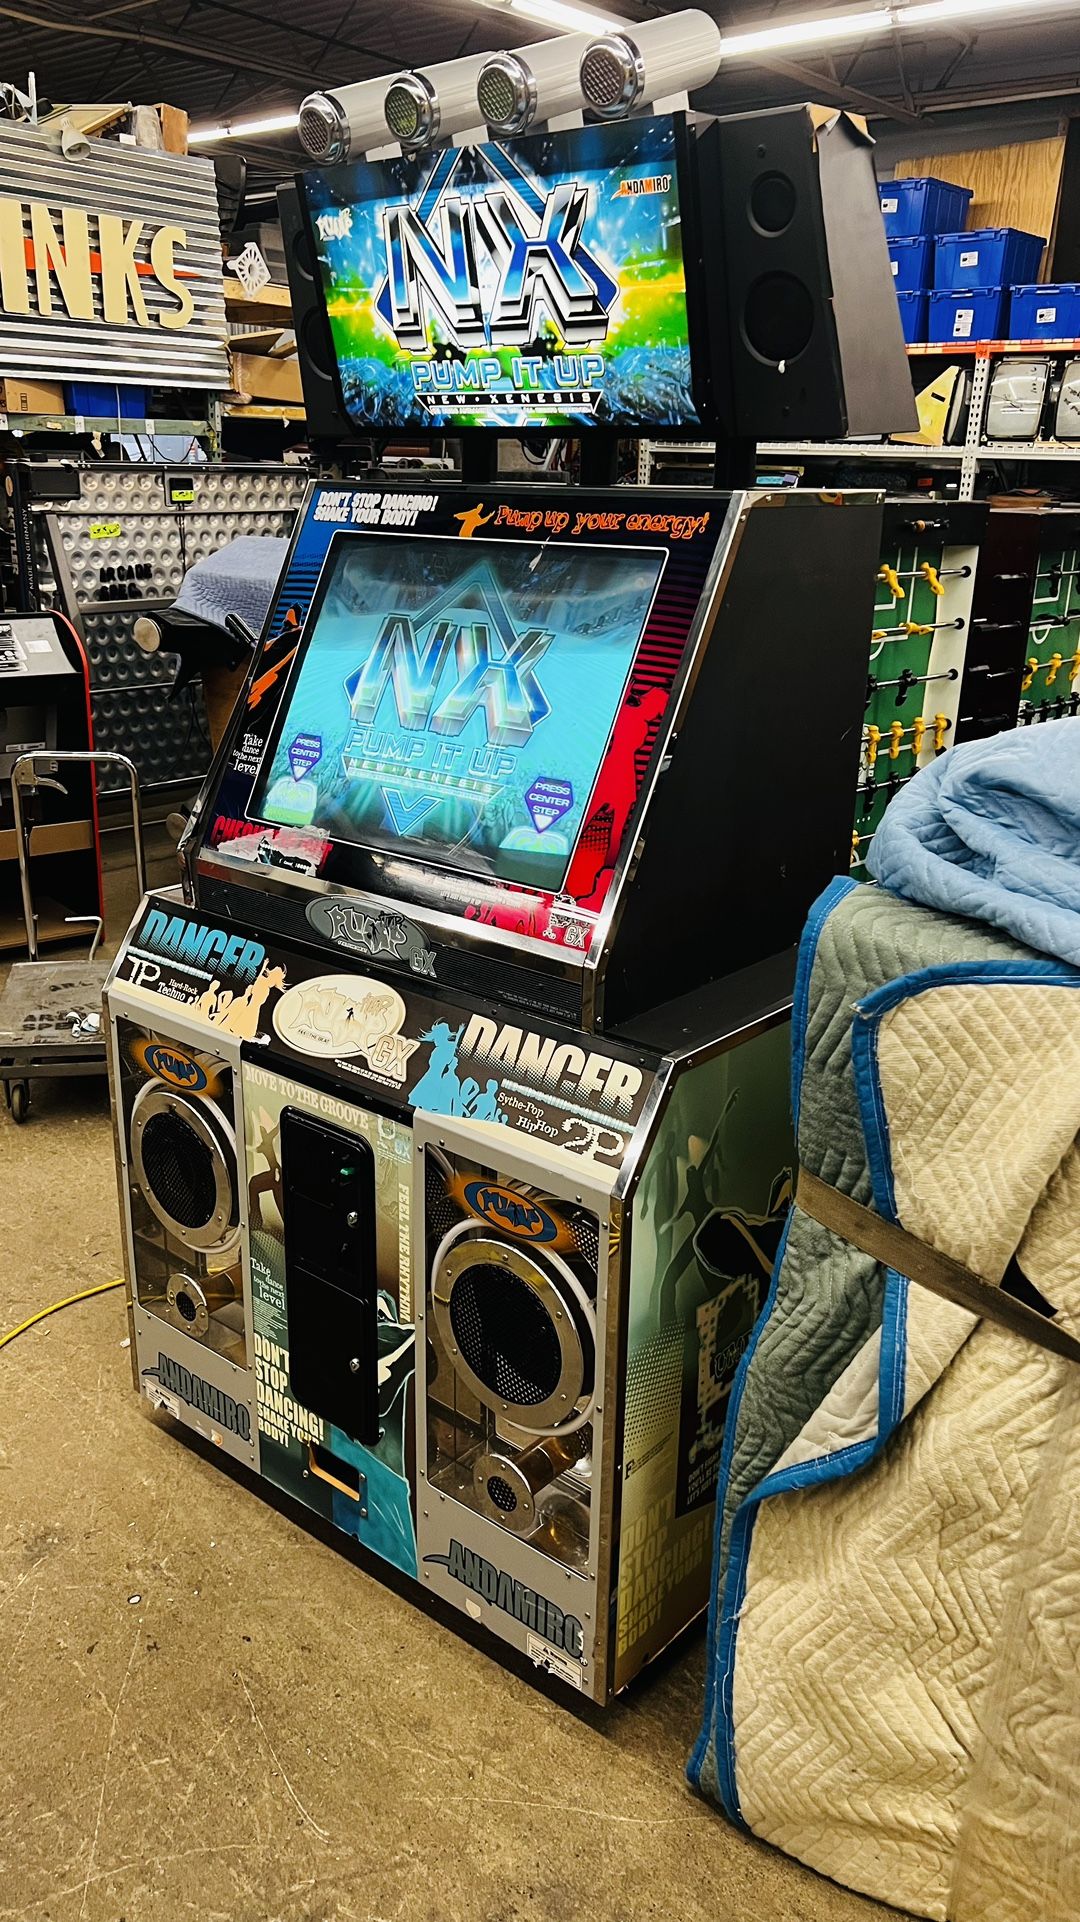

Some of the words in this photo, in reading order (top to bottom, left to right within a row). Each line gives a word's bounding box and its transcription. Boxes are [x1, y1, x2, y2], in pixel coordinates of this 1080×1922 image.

[614, 174, 671, 198] ANDAMIRO
[383, 182, 609, 356] NX
[410, 357, 501, 390] PUMP
[511, 356, 543, 388] IT
[553, 354, 605, 387] UP
[427, 394, 466, 404] NEW
[313, 506, 350, 522] SHAKE
[351, 507, 381, 524] YOUR
[380, 509, 419, 526] BODY!
[318, 491, 352, 507] DON'T
[351, 493, 381, 509] STOP
[381, 493, 439, 511] DANCING!
[21, 508, 31, 552] GERMANY
[494, 505, 542, 532] Pump
[544, 511, 569, 533] up
[571, 512, 627, 534] your
[626, 511, 710, 540] energy!
[26, 553, 32, 564] IN
[26, 565, 35, 590] MADE
[348, 613, 556, 748] NX
[241, 745, 260, 755] dance
[243, 733, 264, 747] Take
[291, 747, 320, 758] CENTER
[295, 738, 321, 749] PRESS
[344, 728, 427, 762] PUMP
[431, 742, 464, 770] IT
[468, 748, 517, 780] UP
[233, 759, 260, 775] level
[292, 758, 313, 767] STEP
[529, 793, 570, 807] CENTER
[535, 782, 571, 795] PRESS
[532, 805, 560, 816] STEP
[137, 908, 267, 982] DANCER
[564, 926, 590, 948] GX
[157, 981, 186, 1002] Techno
[370, 1034, 416, 1078] GX
[457, 1013, 644, 1118] DANCER
[244, 1065, 277, 1092] MOVE
[320, 1096, 370, 1130] GROOVE
[497, 1091, 544, 1119] Sythe-Pop
[561, 1117, 625, 1161] 2P
[398, 1182, 410, 1222] FEEL
[250, 1257, 271, 1276] Take
[265, 1274, 284, 1291] dance
[258, 1286, 286, 1311] level
[254, 1332, 290, 1375] DON'T
[255, 1358, 288, 1394] STOP
[146, 1352, 251, 1442] ANDAMIRO
[256, 1379, 325, 1442] DANCING!
[257, 1400, 290, 1434] SHAKE
[258, 1417, 289, 1449] BODY!
[619, 1512, 711, 1617] DANCING!
[620, 1525, 669, 1589] STOP
[430, 1537, 584, 1660] ANDAMIRO
[618, 1581, 667, 1638] SHAKE
[617, 1602, 662, 1658] BODY!
